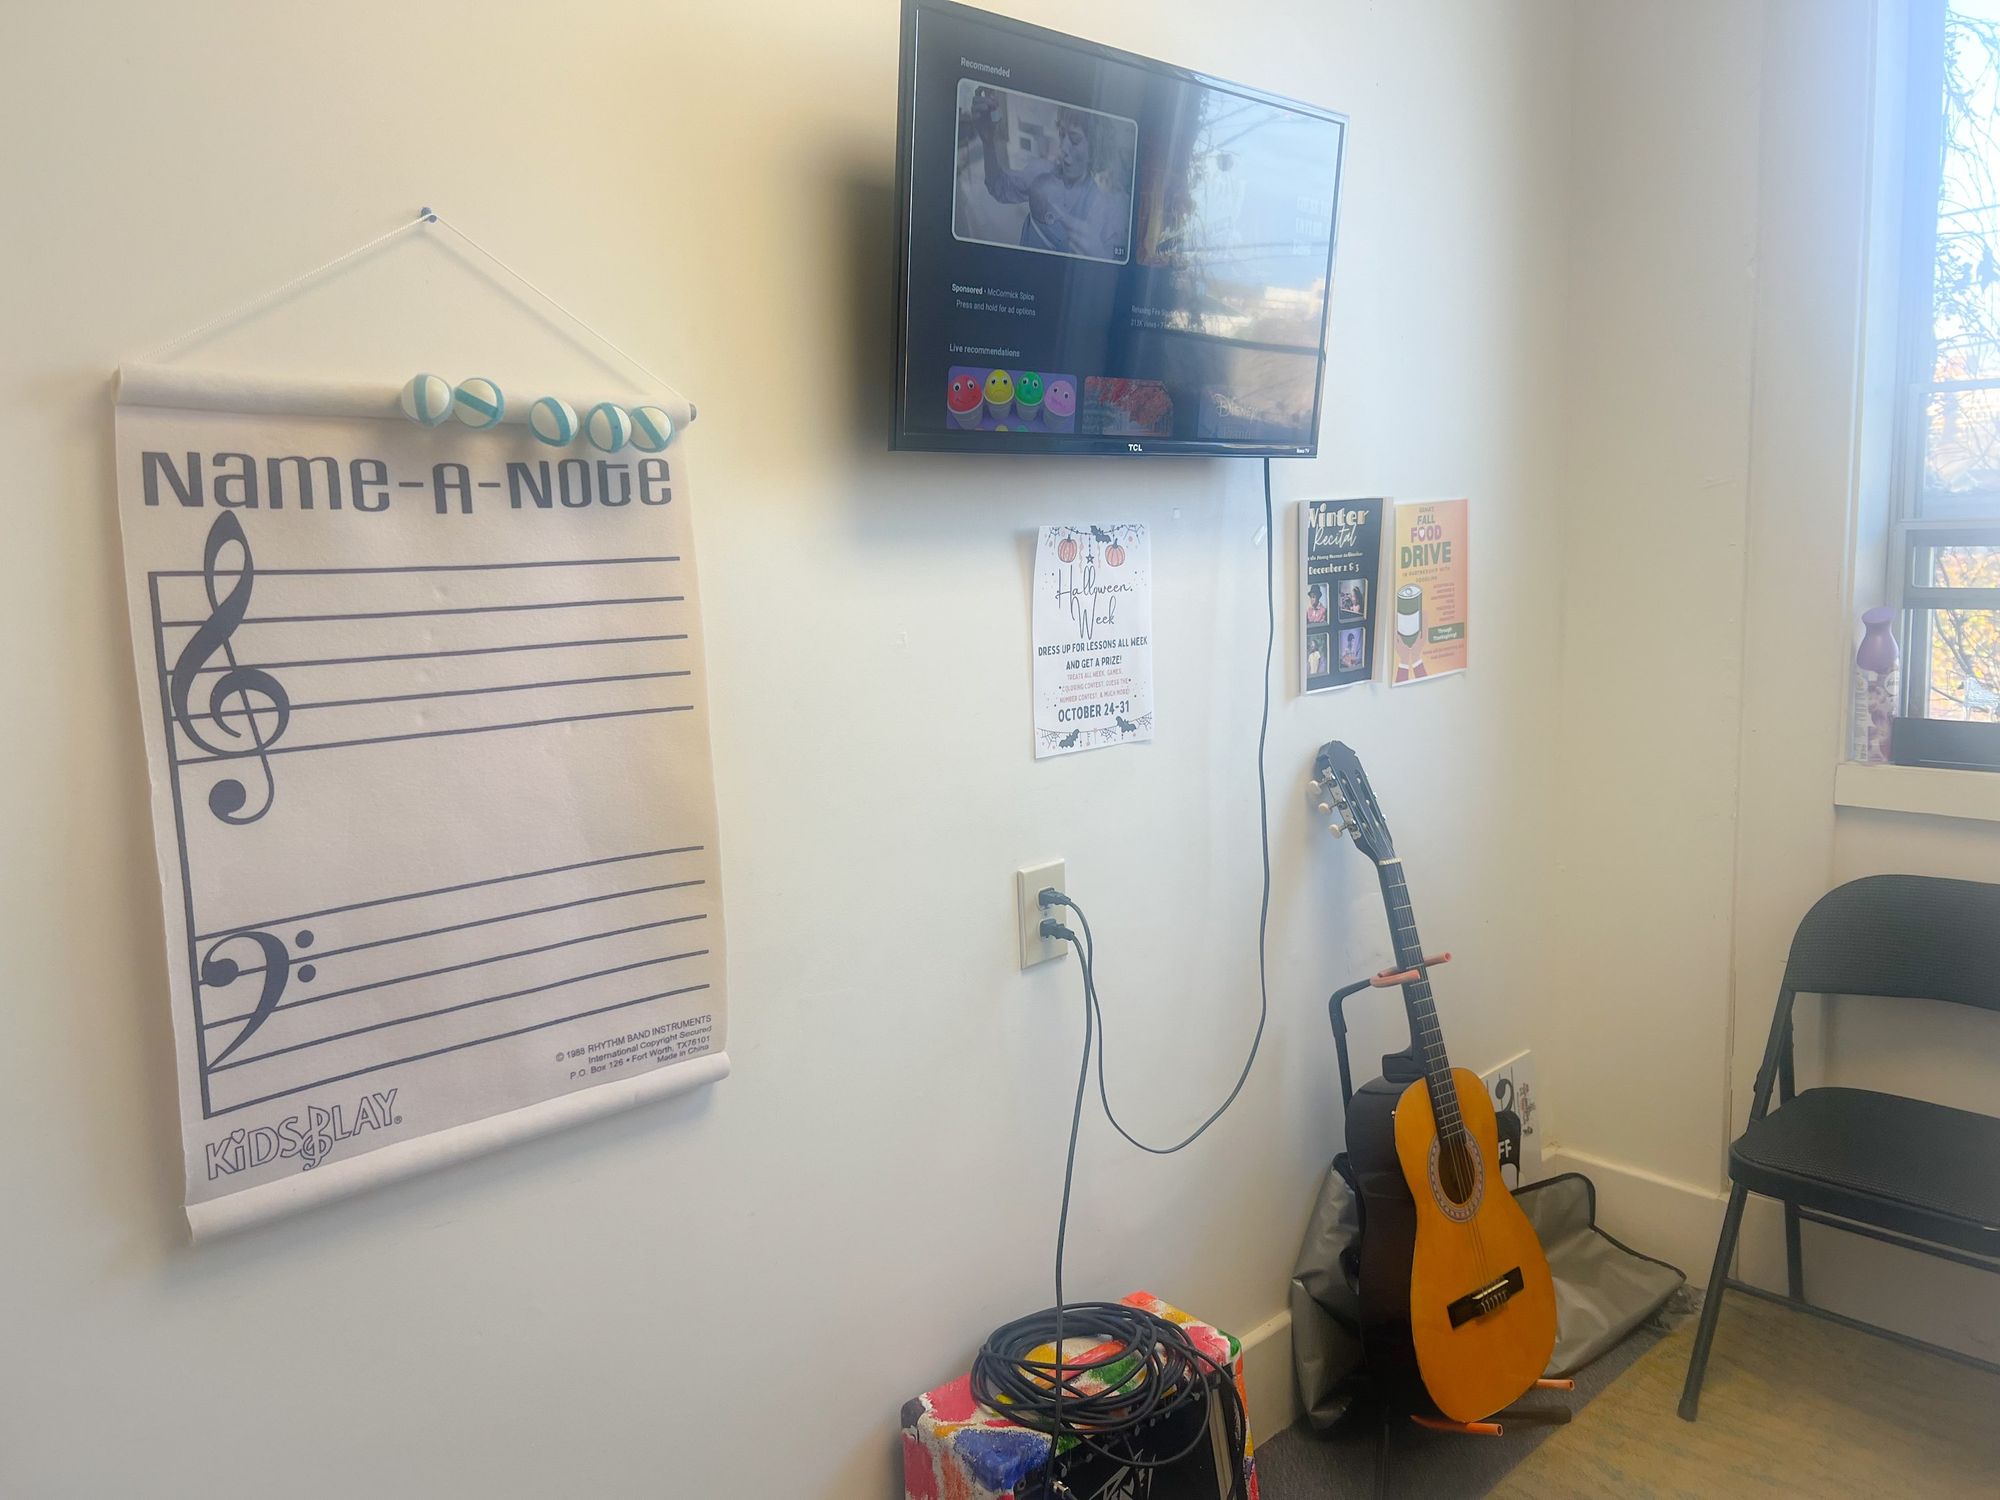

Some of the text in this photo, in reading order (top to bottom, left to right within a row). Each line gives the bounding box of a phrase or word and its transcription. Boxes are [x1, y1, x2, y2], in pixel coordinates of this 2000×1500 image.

[960, 56, 1011, 78] Recommended
[952, 283, 1035, 301] Sponsored McCormick Spice
[956, 299, 1036, 317] Press and hold for ad options
[949, 343, 1020, 358] Live recommendations
[1128, 443, 1143, 452] TCL
[1417, 514, 1435, 525] FALL
[1312, 523, 1357, 552] Recital
[1411, 525, 1442, 543] FOOD
[1401, 542, 1452, 569] DRIVE
[1309, 563, 1343, 575] December
[1072, 592, 1117, 640] Week
[1038, 636, 1148, 656] DRESS UP FOR LESSONS ALL WEEK
[1066, 655, 1122, 670] AND GET A PRIZE!
[1058, 700, 1130, 722] OCTOBER 24-31
[587, 1036, 625, 1054] RHYTHM
[627, 1029, 651, 1044] BAND
[651, 1014, 712, 1036] INSTRUMENTS
[588, 1025, 712, 1064] International Copyright Secured
[657, 1052, 678, 1063] Made
[687, 1044, 709, 1055] China
[590, 1064, 607, 1074] Box
[609, 1058, 624, 1069] 126
[631, 1052, 648, 1063] Fort
